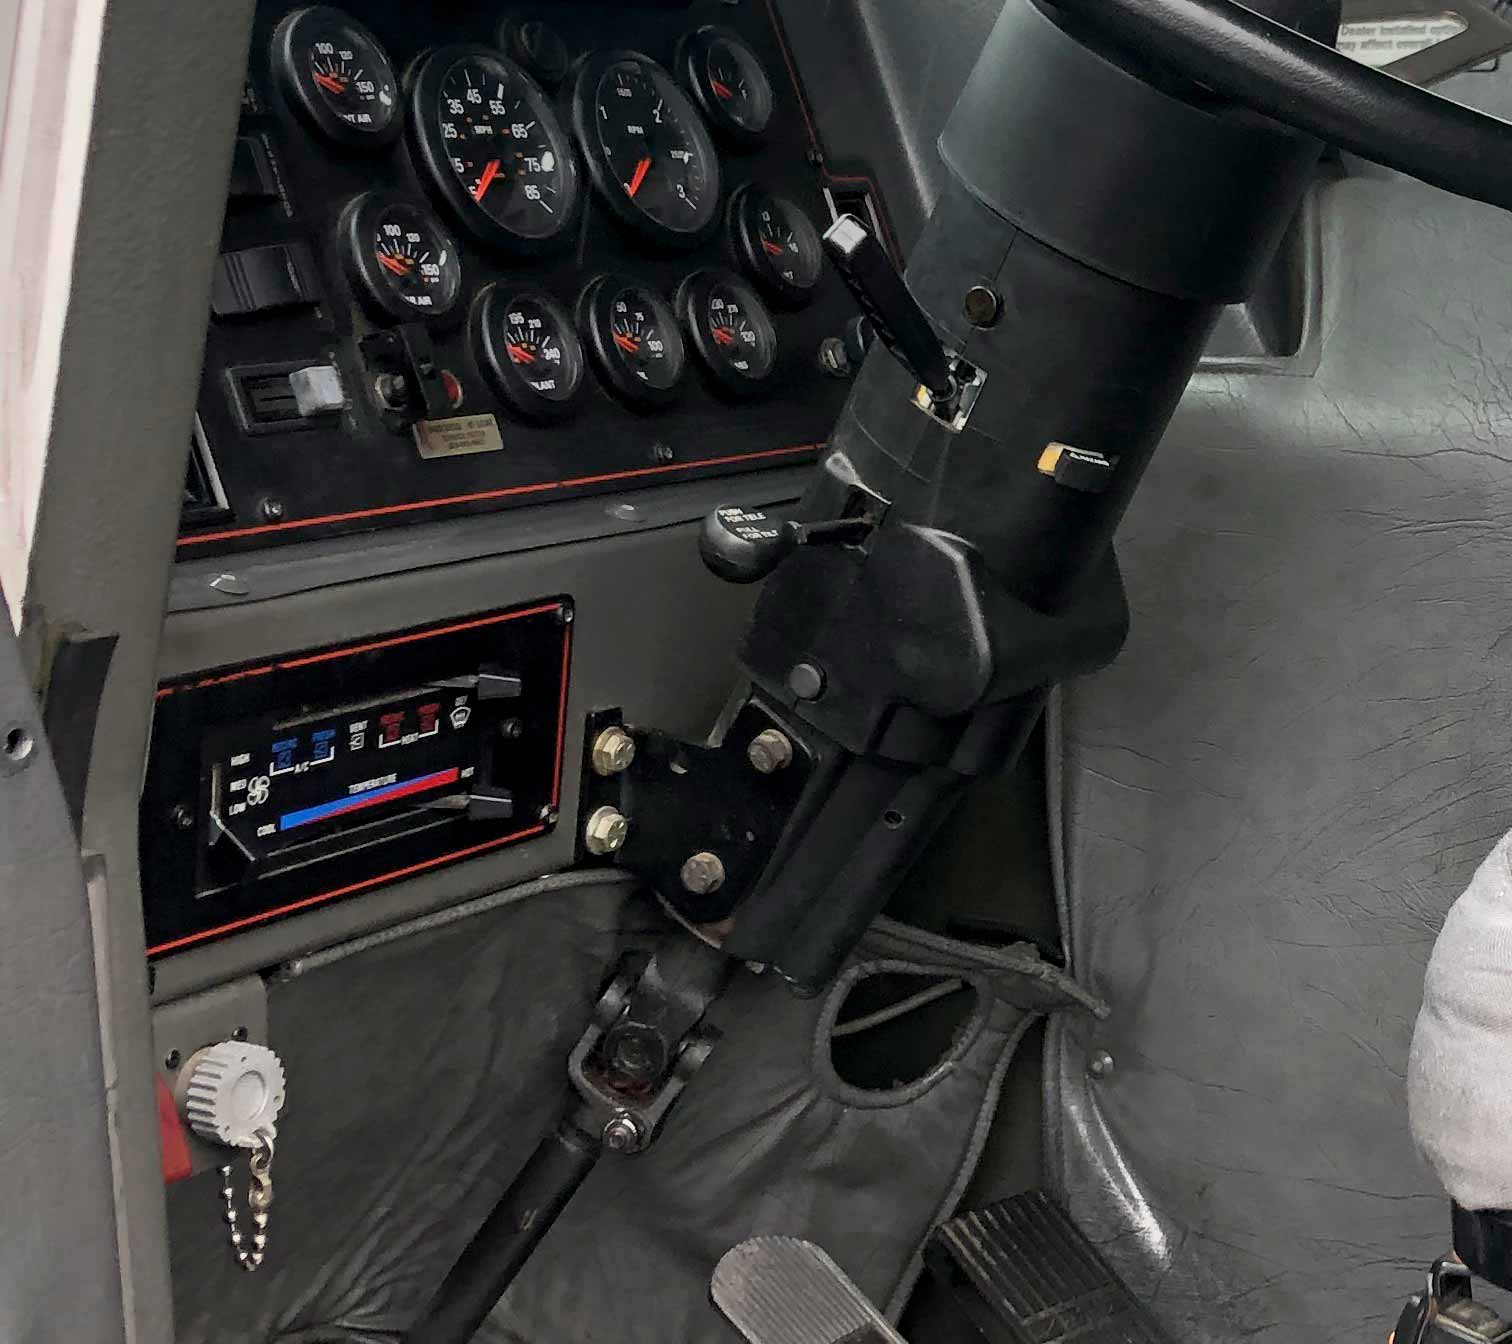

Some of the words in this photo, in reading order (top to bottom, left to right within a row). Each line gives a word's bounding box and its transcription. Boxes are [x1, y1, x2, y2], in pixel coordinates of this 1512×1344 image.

[315, 42, 334, 55] 100
[356, 81, 375, 93] 150
[466, 88, 482, 104] 45
[447, 98, 464, 114] 35
[489, 99, 506, 115] 55
[442, 122, 458, 138] 25
[473, 125, 493, 135] MPH
[511, 122, 528, 139] 65
[627, 125, 644, 134] RPM
[524, 157, 541, 172] 75
[524, 184, 541, 200] 85
[676, 184, 686, 199] 3
[383, 224, 401, 237] 100
[421, 263, 440, 276] 150
[648, 340, 664, 352] 100
[348, 772, 398, 794] TEMPERATURE
[228, 802, 247, 816] LOW
